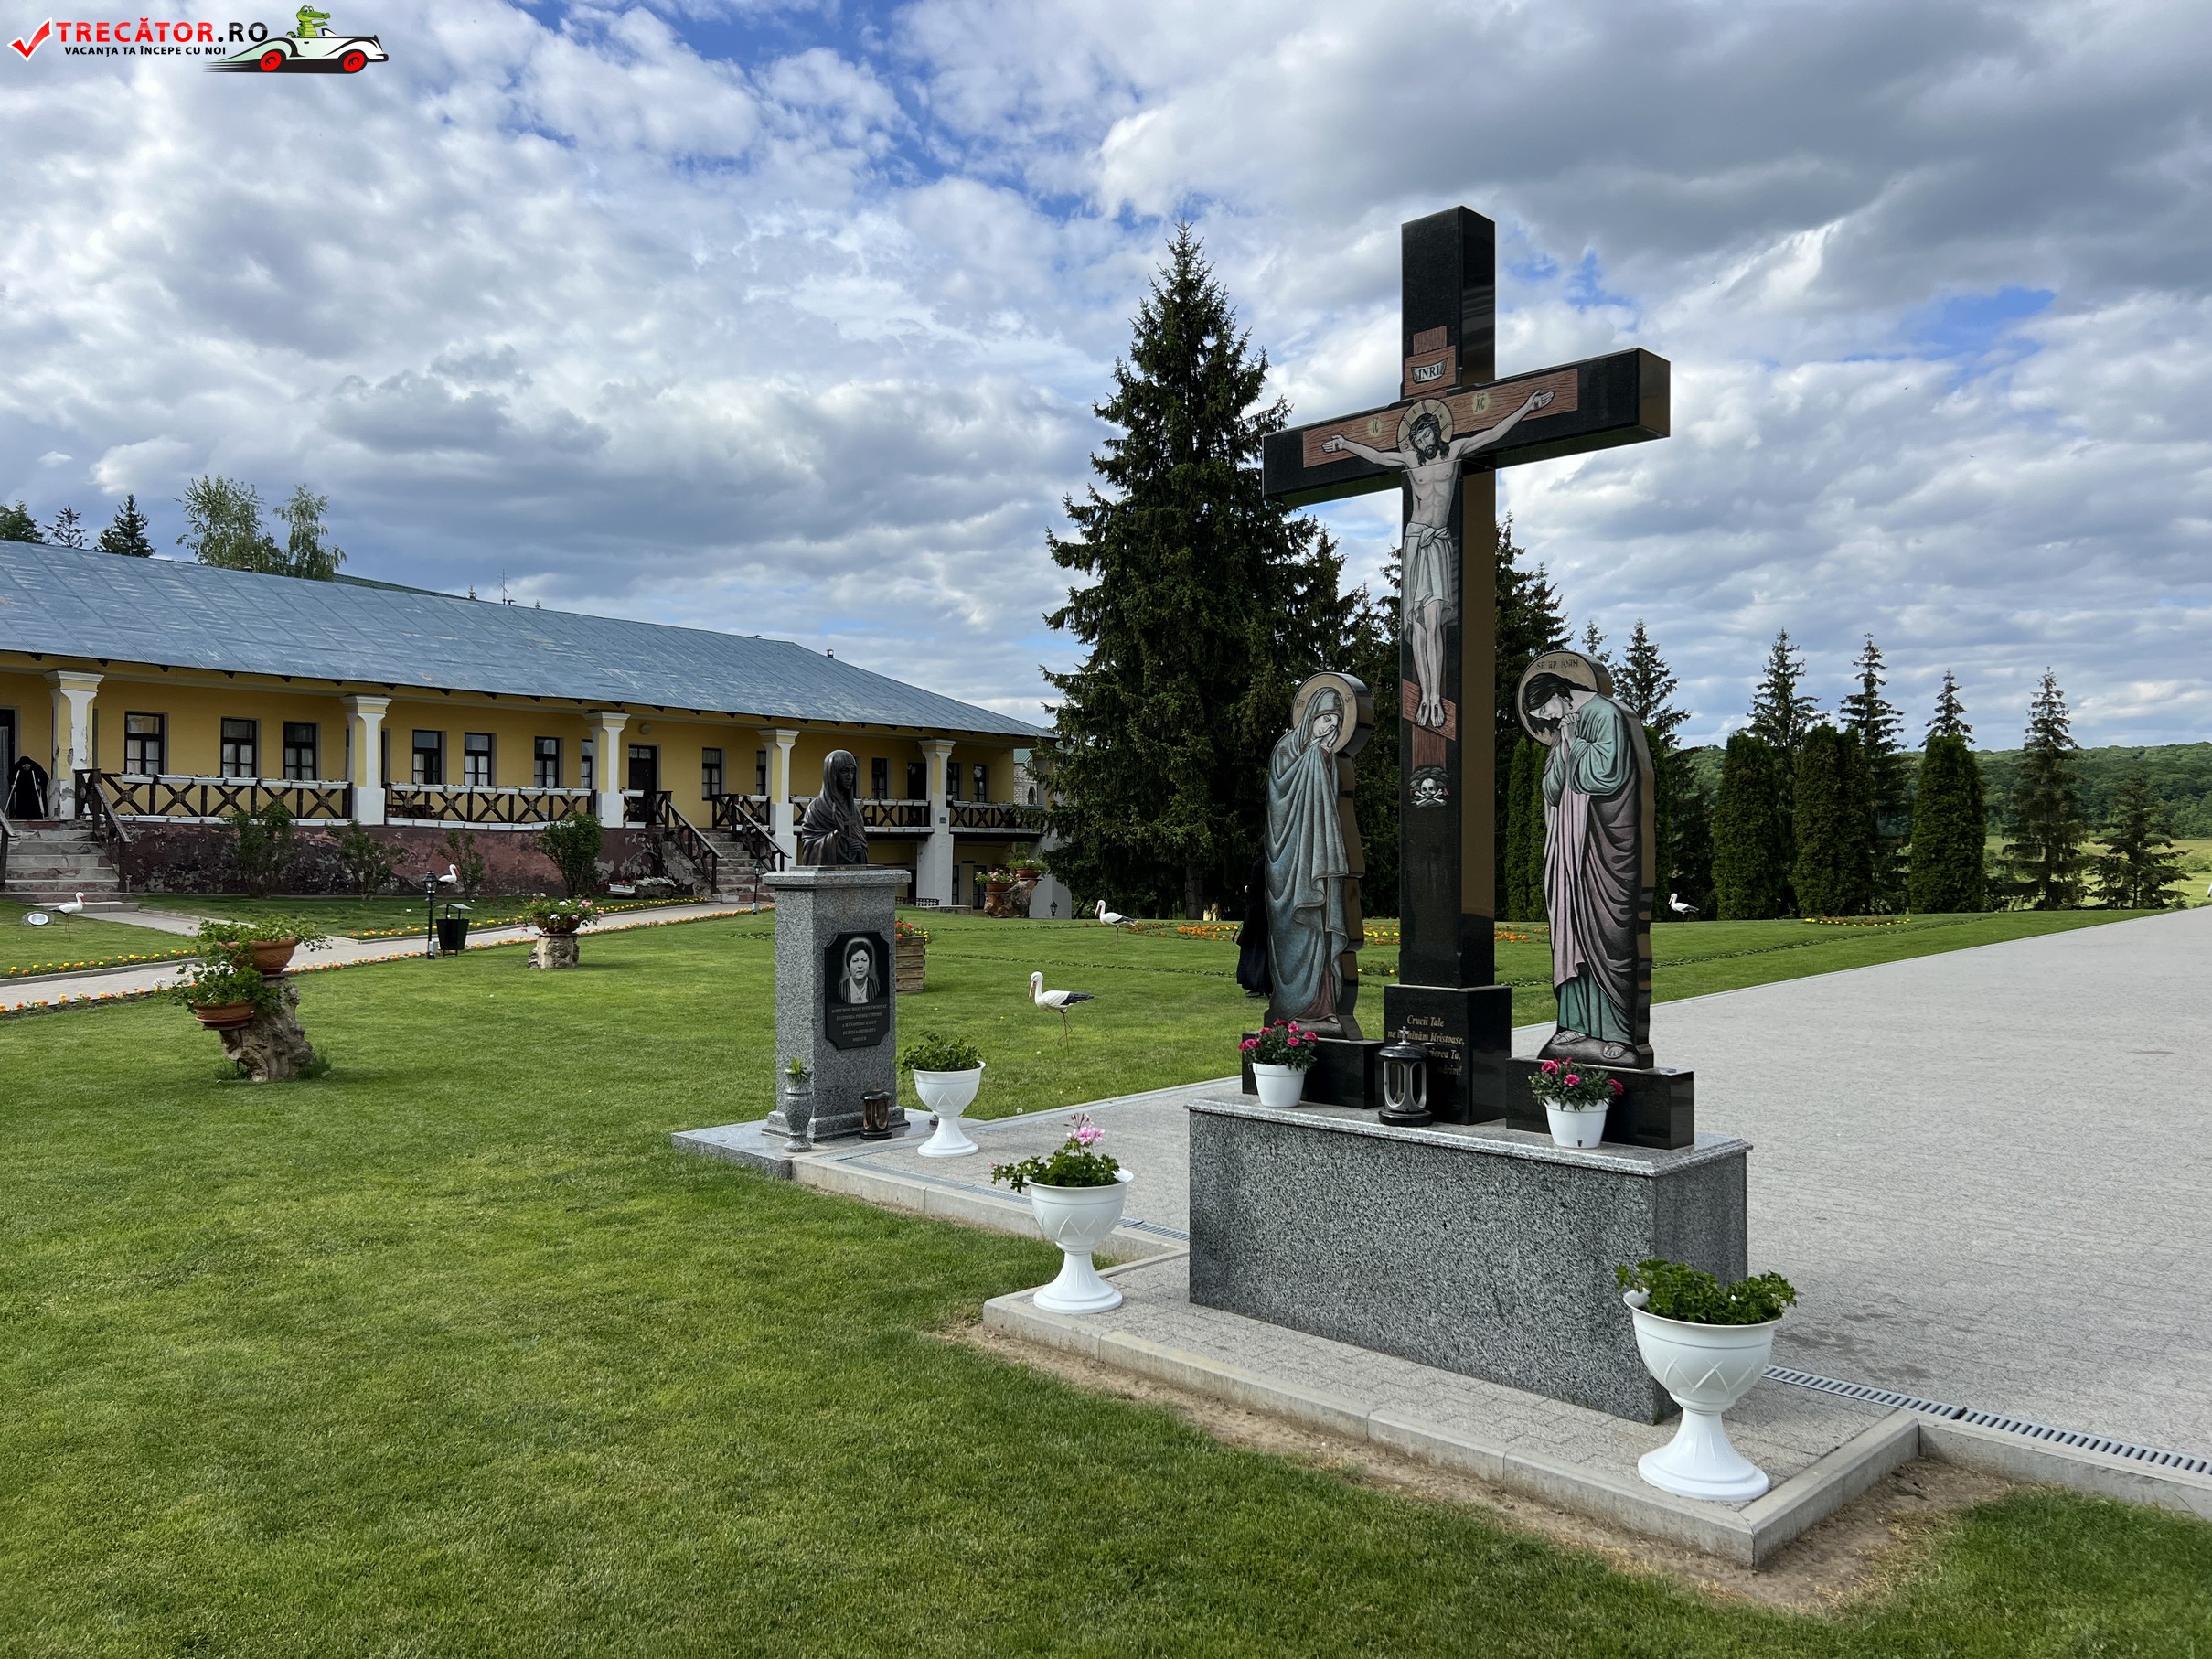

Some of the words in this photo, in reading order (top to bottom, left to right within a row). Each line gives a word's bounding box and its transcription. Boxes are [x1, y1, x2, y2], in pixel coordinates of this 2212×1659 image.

[1418, 365, 1441, 380] INRI
[1406, 1014, 1428, 1026] Crucii
[1430, 1016, 1445, 1028] Tale
